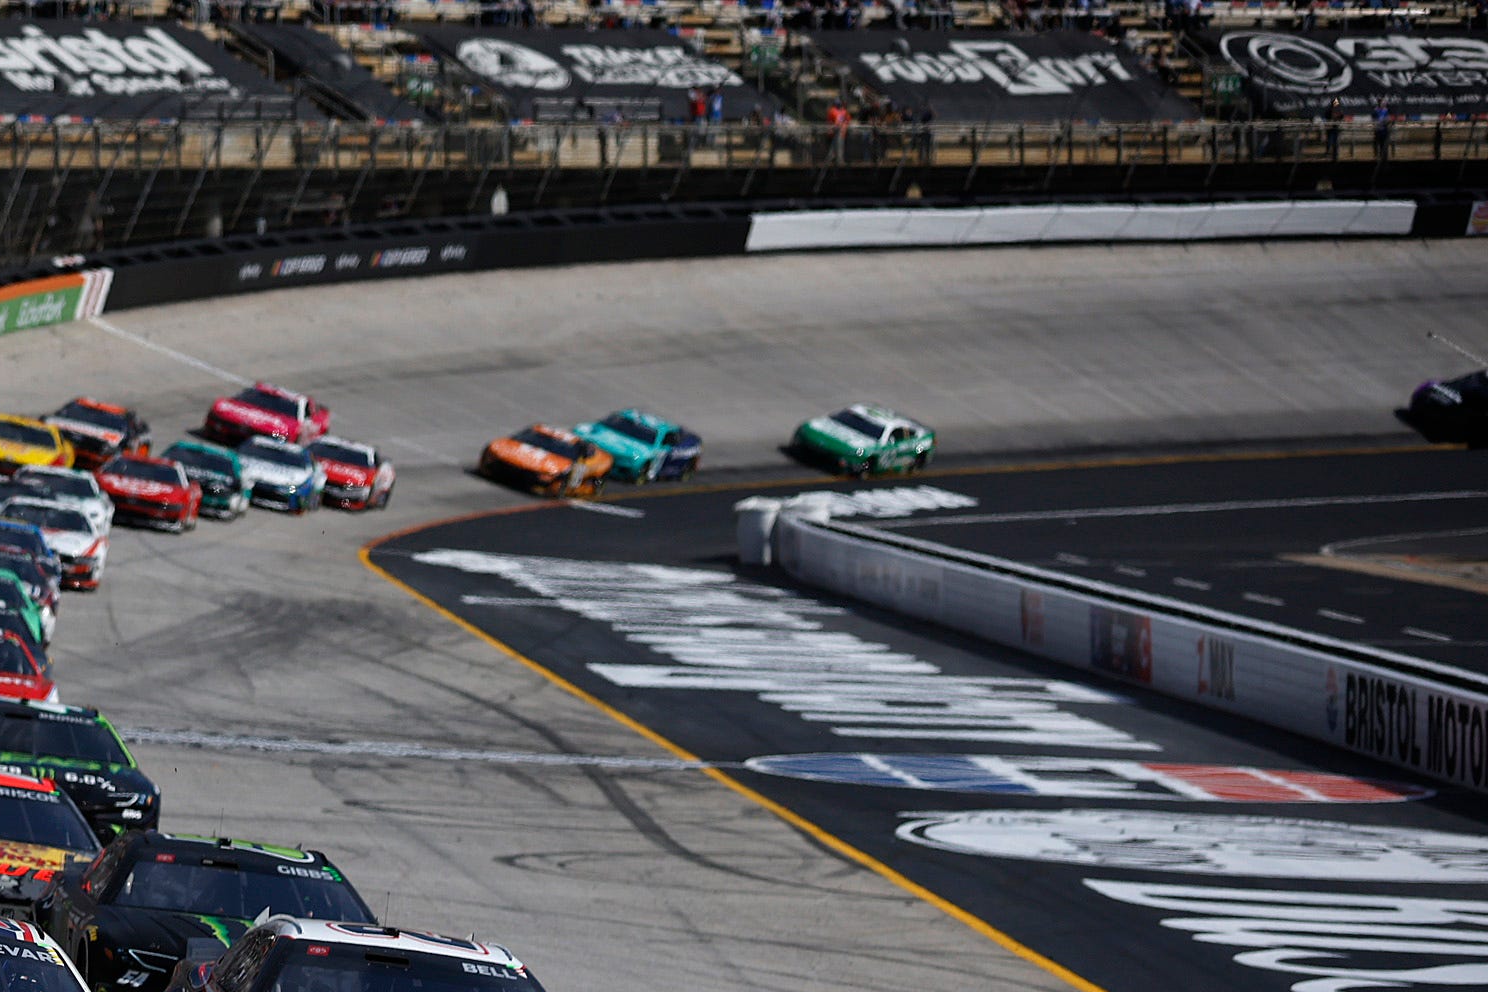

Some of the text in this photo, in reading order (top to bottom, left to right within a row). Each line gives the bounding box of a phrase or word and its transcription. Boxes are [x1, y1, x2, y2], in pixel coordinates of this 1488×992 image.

[1345, 673, 1488, 792] BRISTOL MOTO
[277, 864, 334, 881] GIBBS
[461, 961, 518, 981] BELL
